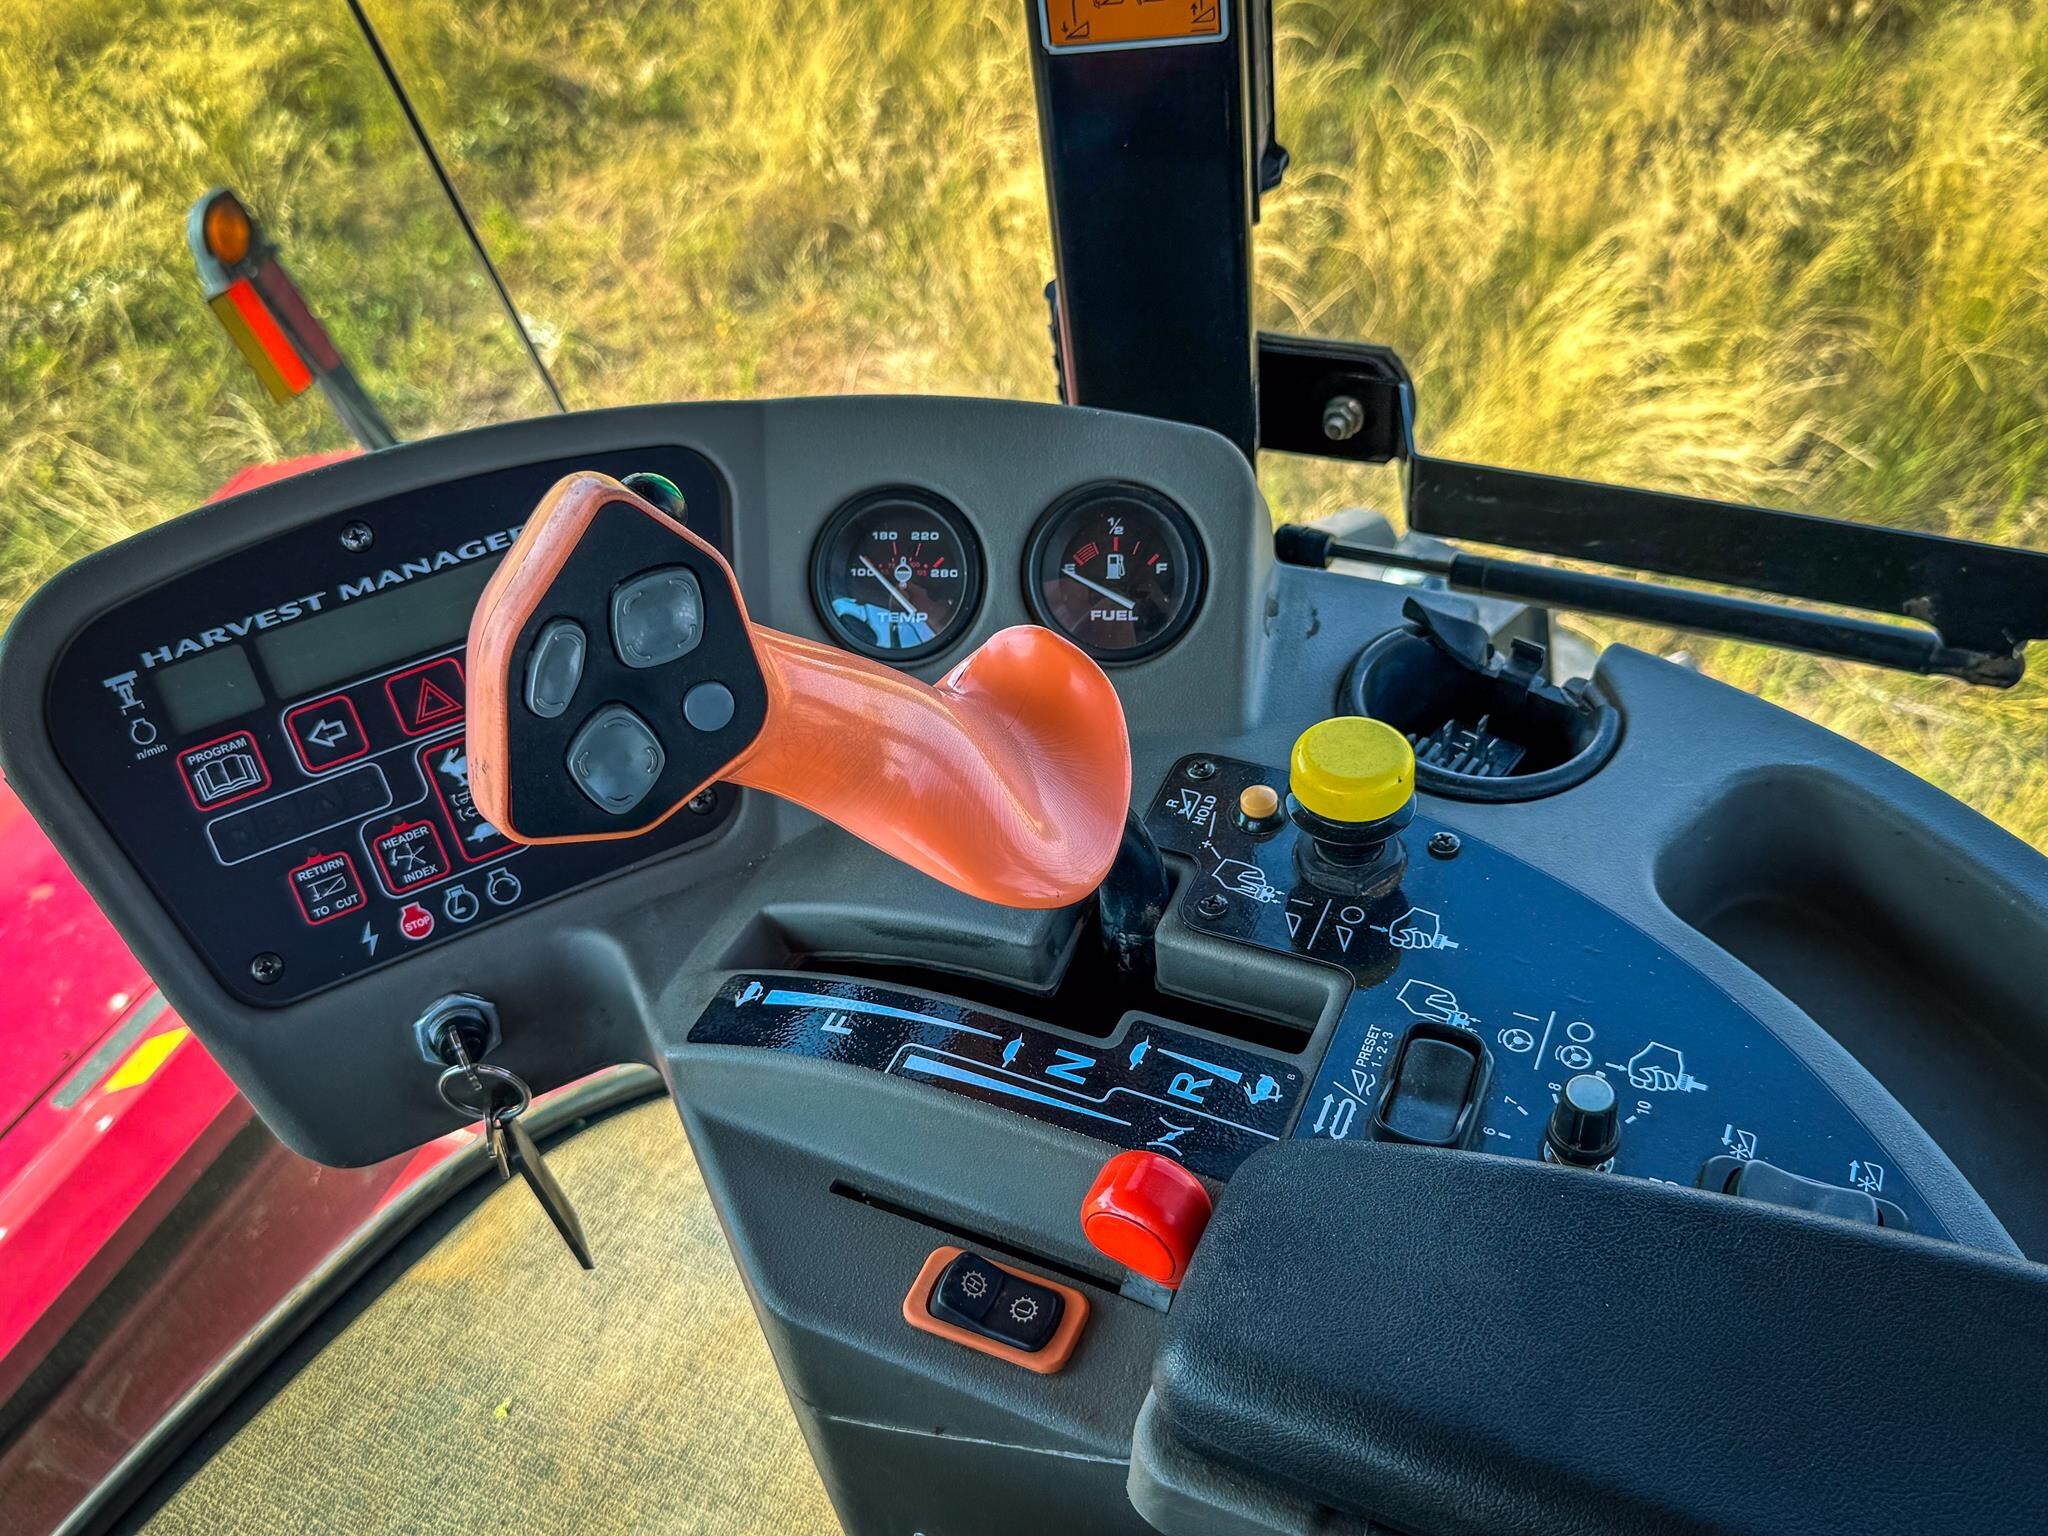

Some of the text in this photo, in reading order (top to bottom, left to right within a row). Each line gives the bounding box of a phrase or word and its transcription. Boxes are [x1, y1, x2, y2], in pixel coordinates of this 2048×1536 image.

[872, 531, 898, 540] 180
[911, 531, 940, 540] 220
[1155, 563, 1168, 574] F
[877, 612, 928, 623] TEMP
[1090, 610, 1139, 621] FUEL
[139, 591, 326, 669] HARVEST
[136, 743, 168, 760] n/min
[187, 737, 248, 765] PROGRAM
[1165, 798, 1179, 808] R
[1192, 795, 1217, 825] HOLD
[382, 826, 430, 850] HEADER
[297, 857, 345, 882] RETURN
[403, 864, 439, 884] INDEX
[312, 894, 359, 918] TO CUT
[404, 915, 431, 932] STOP
[820, 1011, 853, 1036] F
[1355, 1024, 1382, 1068] PRESET
[1045, 1048, 1097, 1085] N
[1166, 1072, 1216, 1103] R
[1547, 1082, 1562, 1092] 8
[1503, 1095, 1518, 1106] 7
[1636, 1100, 1653, 1115] 10
[1482, 1126, 1496, 1136] 6
